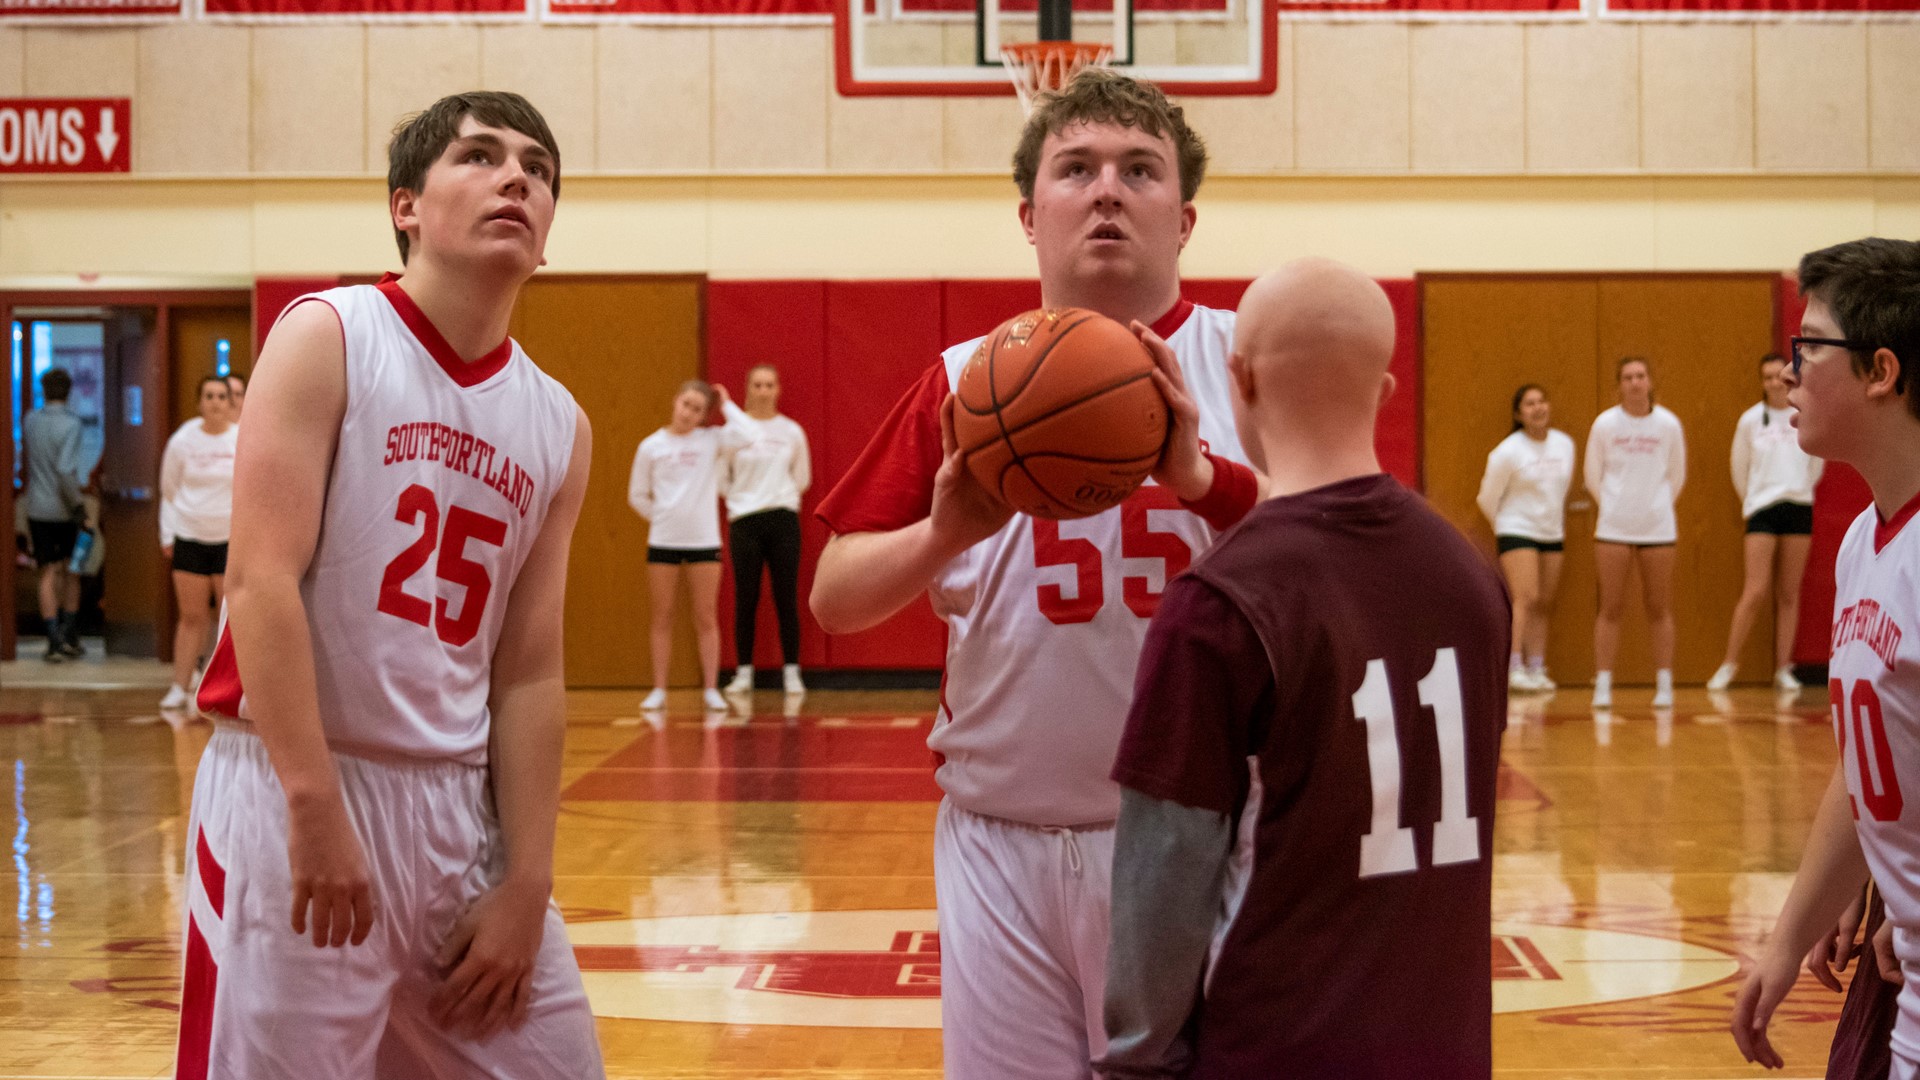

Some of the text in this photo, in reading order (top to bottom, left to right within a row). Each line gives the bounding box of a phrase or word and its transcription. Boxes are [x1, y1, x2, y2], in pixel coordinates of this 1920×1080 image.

[376, 482, 509, 648] 25
[1031, 485, 1192, 625] 55
[1351, 646, 1481, 879] 11
